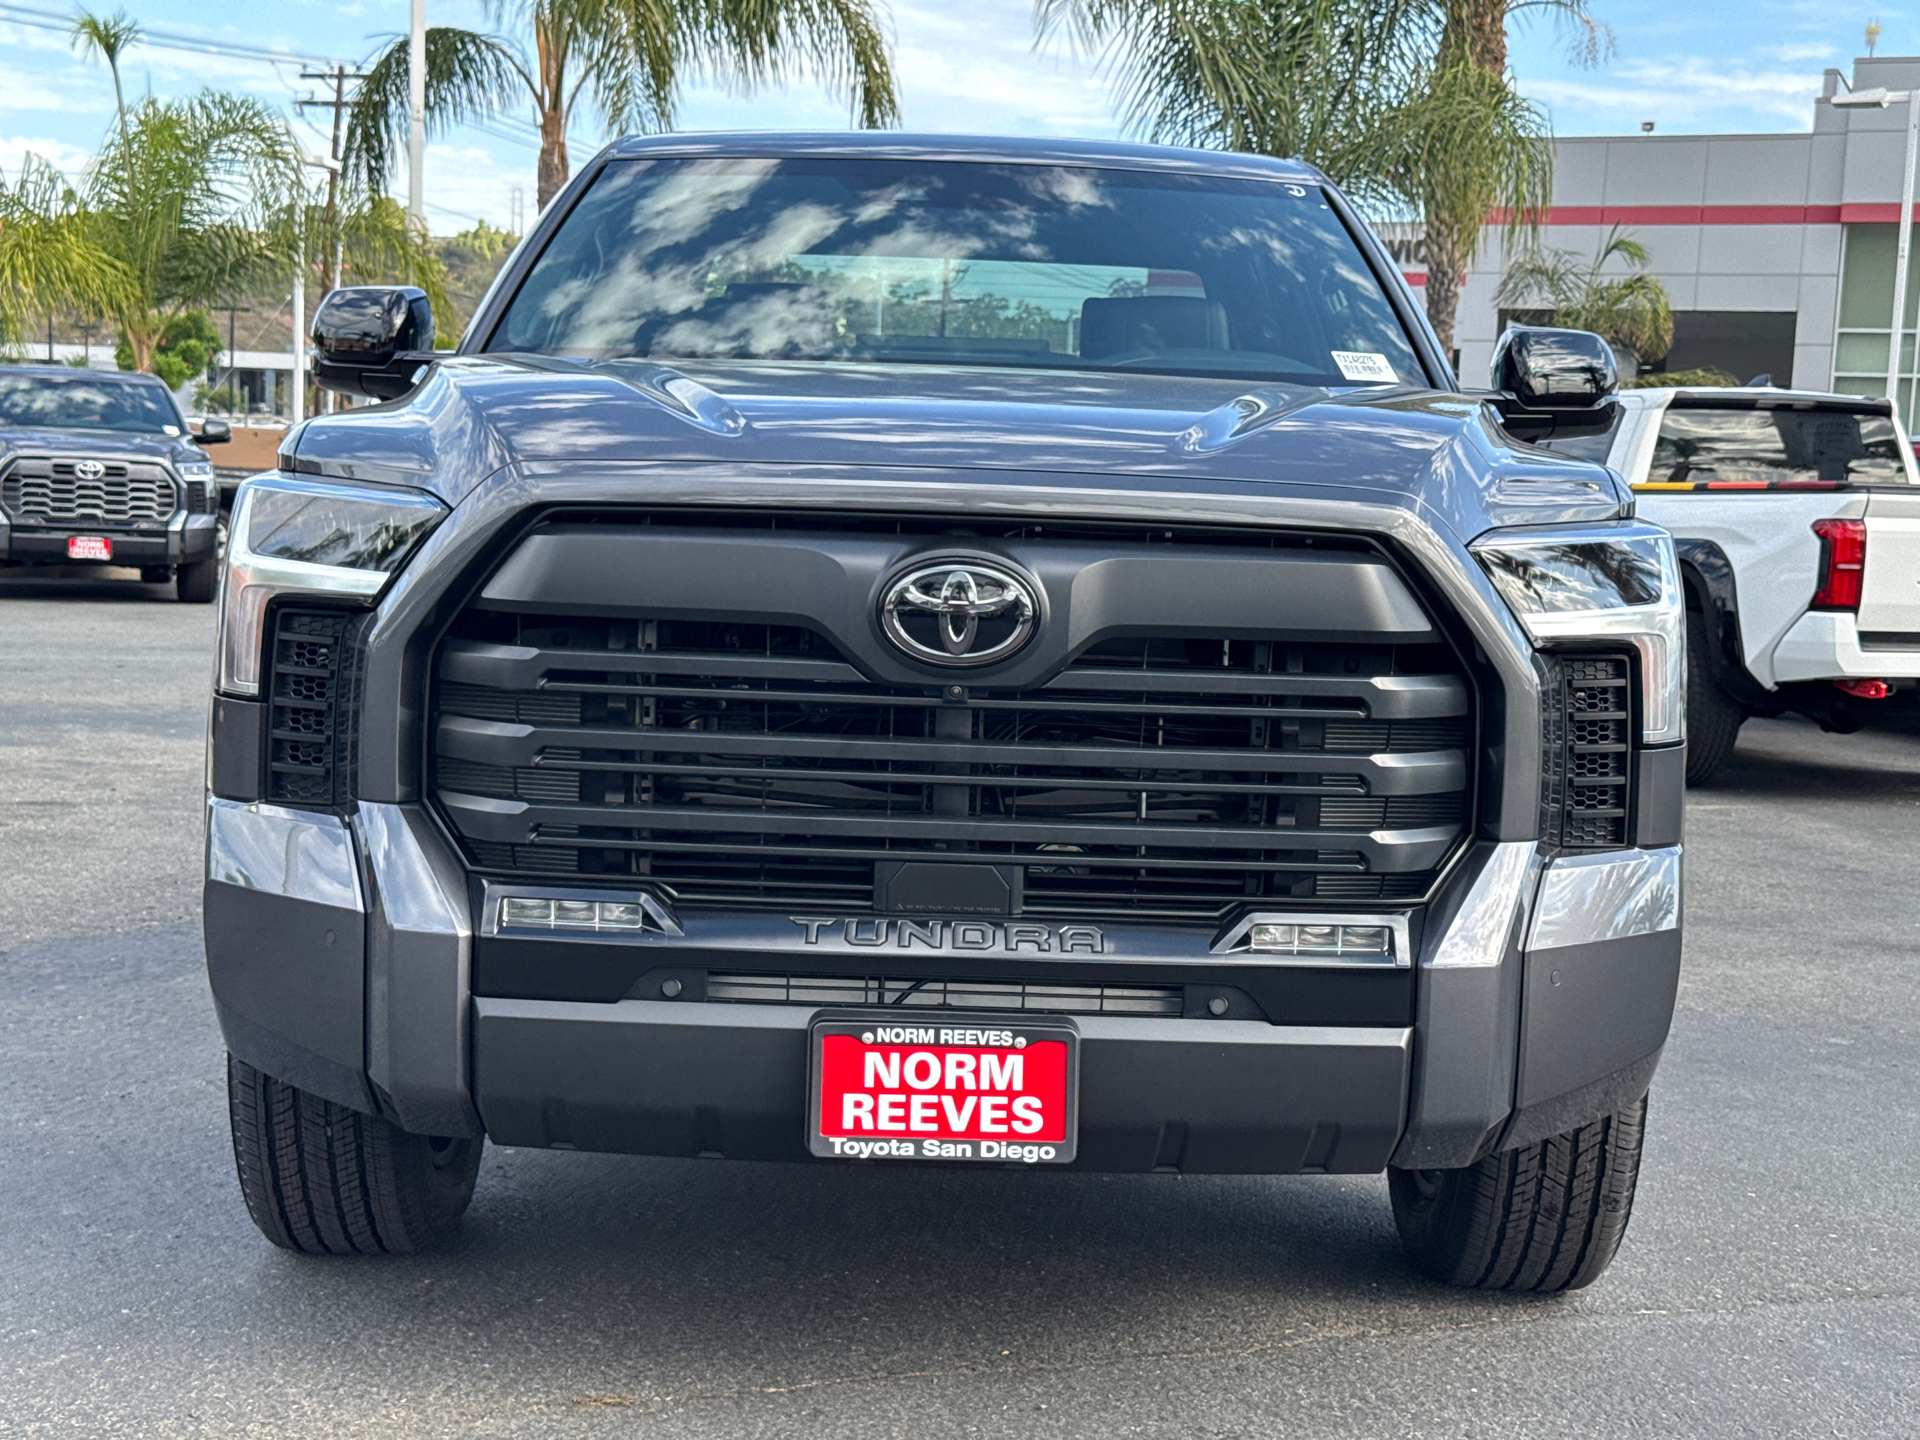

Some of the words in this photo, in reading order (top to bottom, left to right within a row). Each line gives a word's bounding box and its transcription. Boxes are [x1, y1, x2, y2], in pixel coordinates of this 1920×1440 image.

[1381, 240, 1428, 264] VIC
[789, 916, 1104, 953] TUNDRA
[877, 1028, 934, 1044] NORM
[940, 1029, 1013, 1046] REEVES
[863, 1051, 1024, 1091] NORM
[842, 1093, 1044, 1133] REEVES
[829, 1137, 915, 1158] Toyota
[922, 1139, 971, 1157] San
[980, 1141, 1056, 1162] Diego
